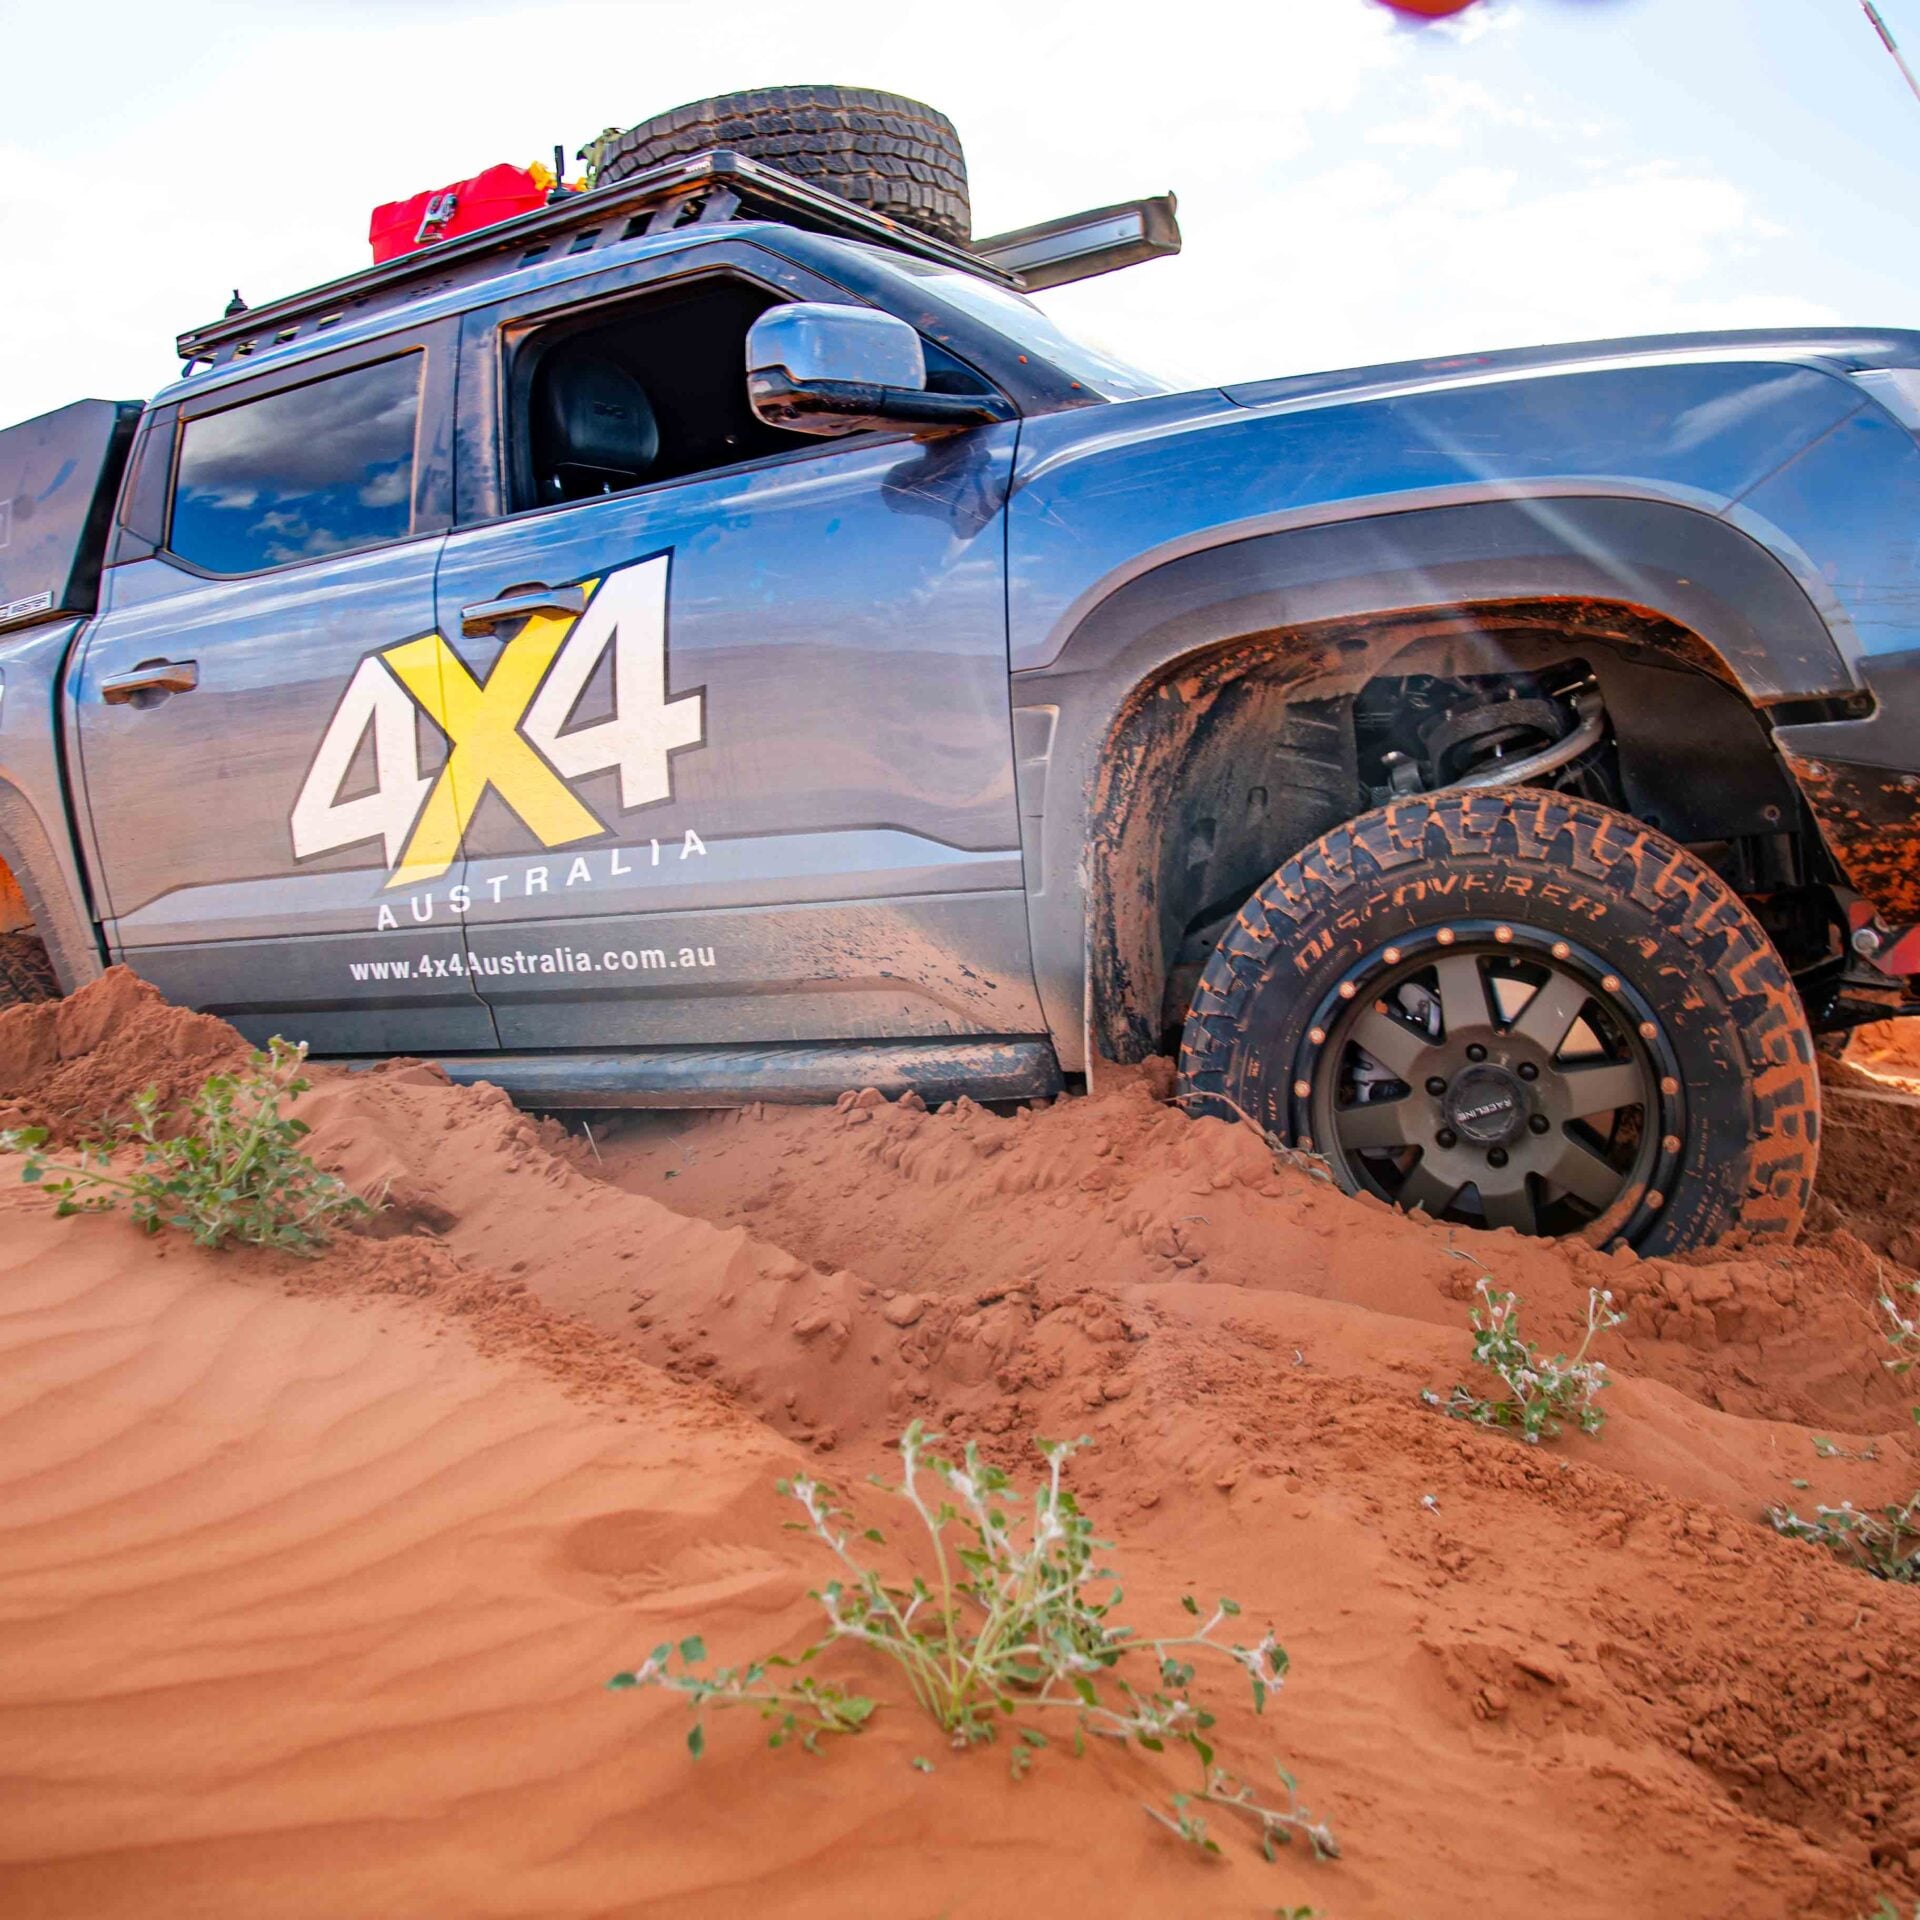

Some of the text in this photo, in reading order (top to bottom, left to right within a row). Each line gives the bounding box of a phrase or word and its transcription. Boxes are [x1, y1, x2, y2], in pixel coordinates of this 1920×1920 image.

[377, 829, 707, 931] AUSTRALIA
[1293, 871, 1608, 973] DISCOVERER
[349, 946, 717, 982] www.4x4Australia.com.au
[1456, 1095, 1513, 1122] RACELINE
